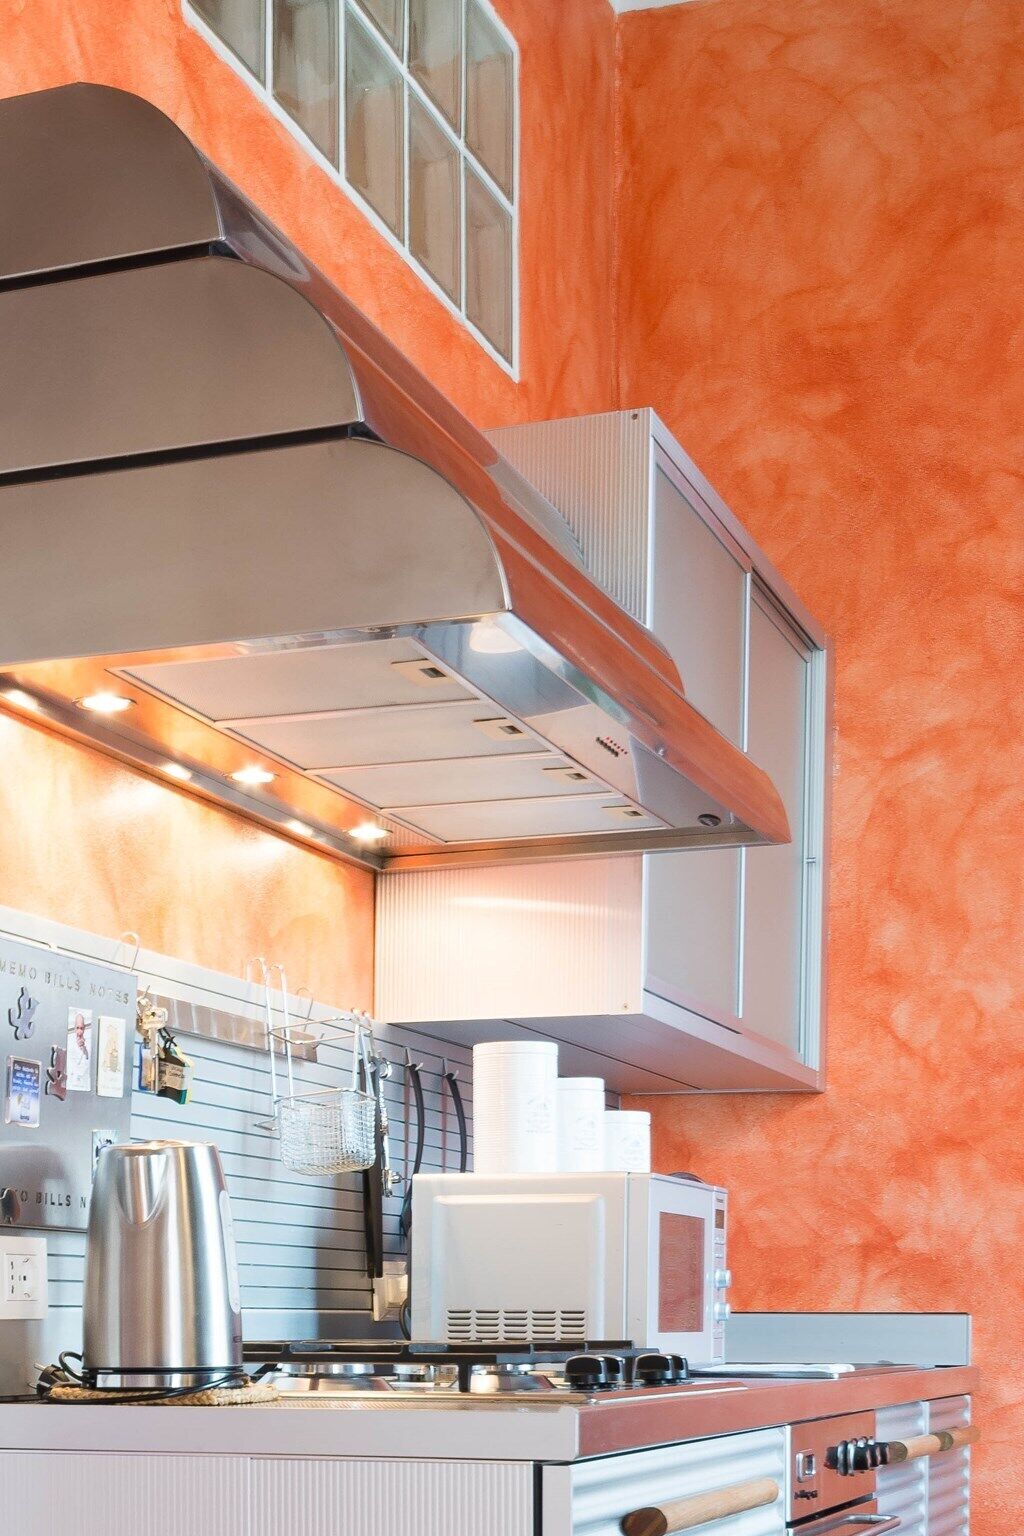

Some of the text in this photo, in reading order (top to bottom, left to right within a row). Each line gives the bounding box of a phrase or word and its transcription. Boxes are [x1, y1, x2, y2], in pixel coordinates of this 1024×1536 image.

[0, 959, 129, 1004] MEMO BILLS NOTES
[36, 1191, 72, 1207] BILLS
